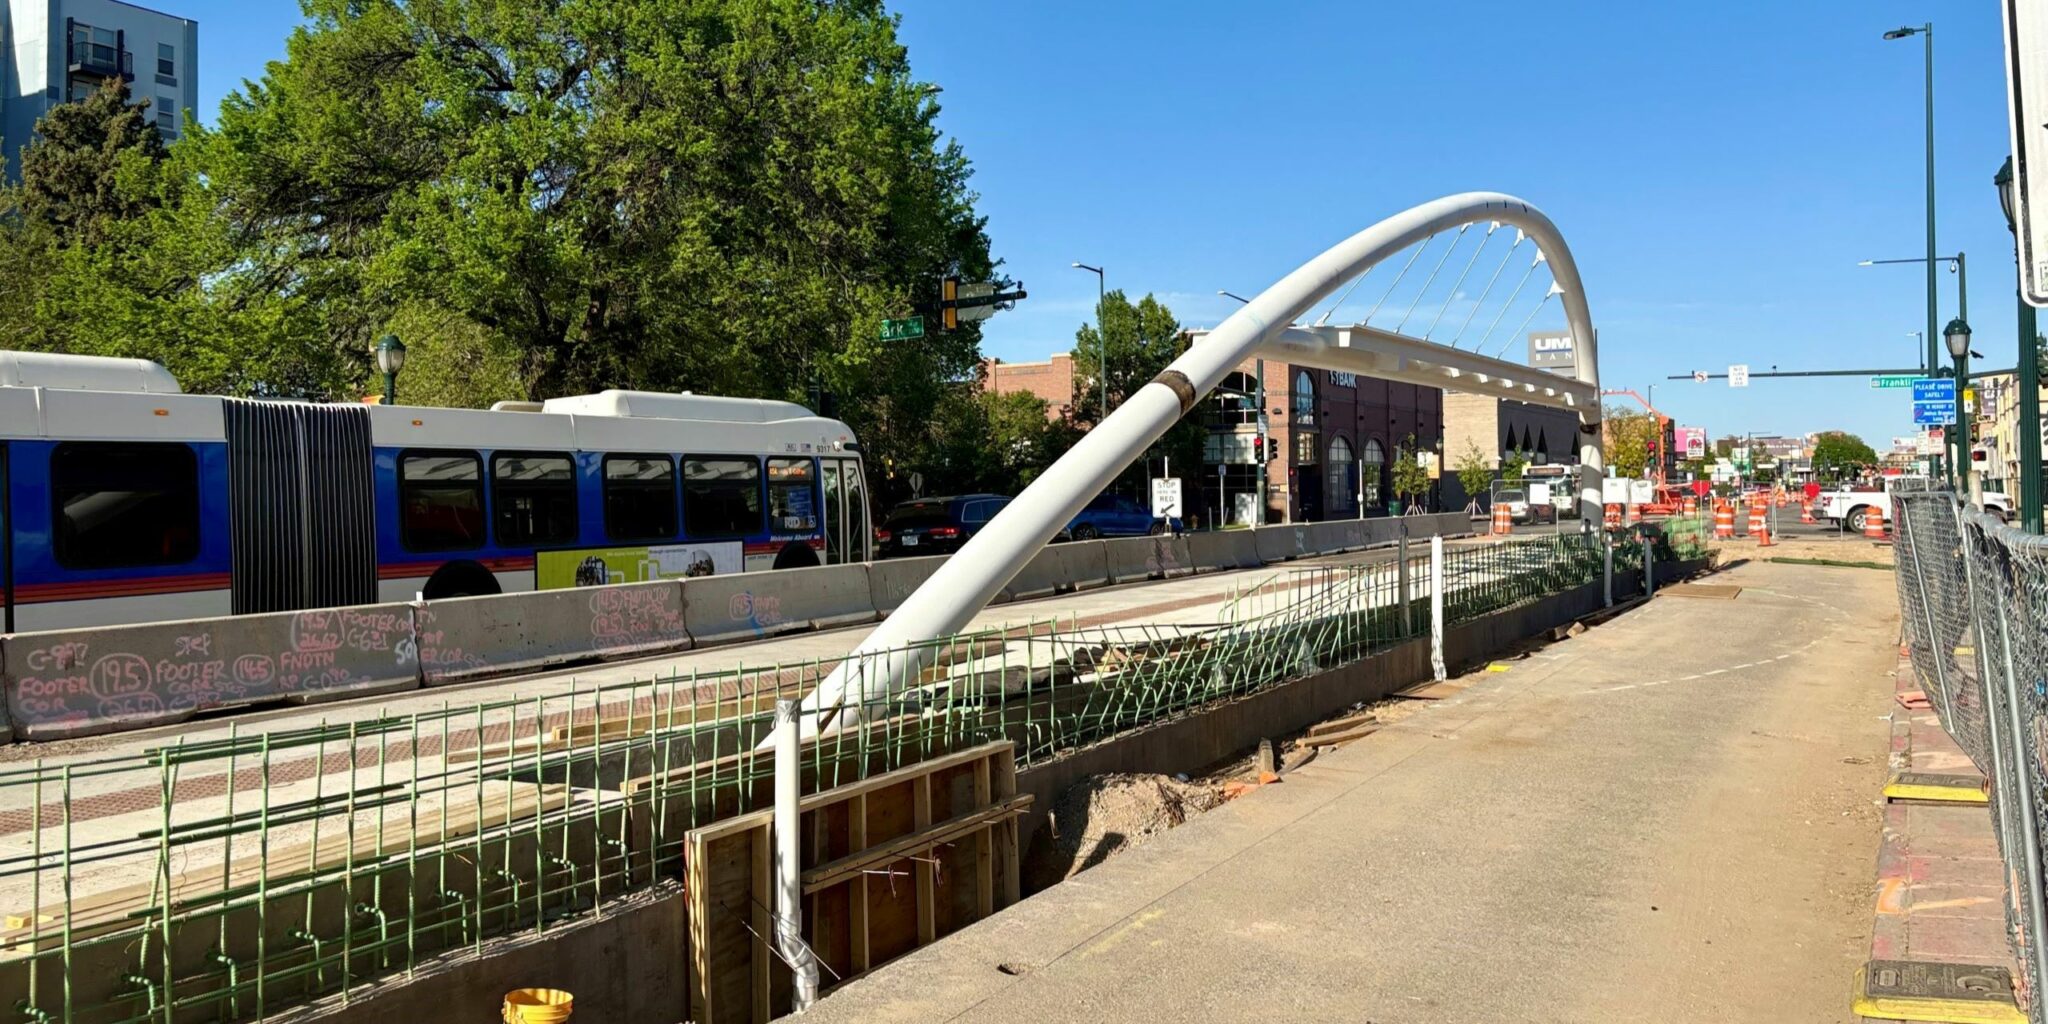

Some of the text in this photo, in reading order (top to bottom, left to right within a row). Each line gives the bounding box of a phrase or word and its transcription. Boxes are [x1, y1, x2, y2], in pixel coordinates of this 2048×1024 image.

[881, 322, 904, 338] ark
[1535, 337, 1572, 350] UM
[1535, 352, 1572, 361] BAN
[1881, 379, 1911, 387] Frankli
[1914, 383, 1935, 391] PLEASE
[17, 676, 92, 700] FOOTER
[155, 657, 229, 684] FOOTER
